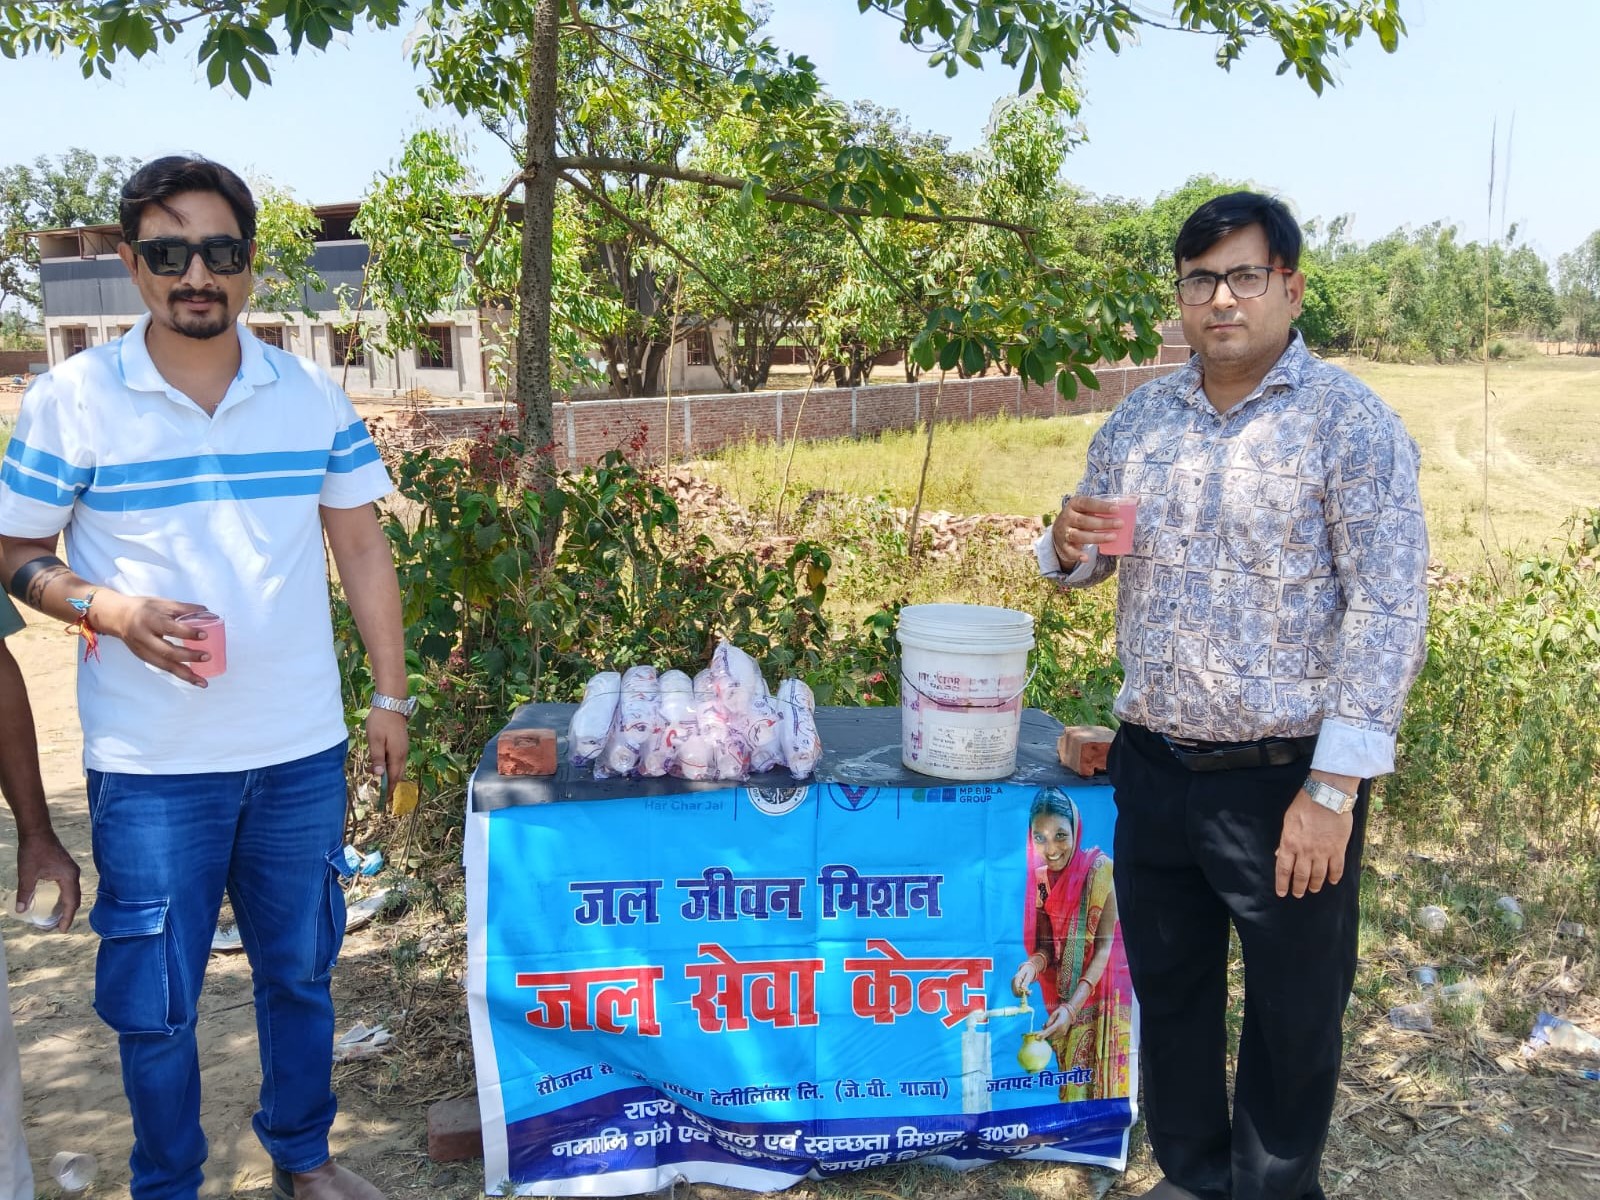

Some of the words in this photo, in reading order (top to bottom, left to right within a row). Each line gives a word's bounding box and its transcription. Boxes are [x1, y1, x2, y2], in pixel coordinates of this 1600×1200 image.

[644, 799, 667, 811] Har
[959, 787, 973, 795] MP
[975, 787, 1003, 795] BIRLA
[959, 795, 992, 804] GROUP
[568, 879, 663, 926] जल
[675, 865, 805, 923] जीवन
[818, 863, 944, 919] मिशन
[515, 965, 664, 1037] जल
[685, 942, 825, 1033] सेवा
[844, 938, 993, 1030] केन्द्र
[535, 1064, 594, 1096] सौजन्य
[797, 1081, 825, 1101] लि.
[900, 1077, 949, 1100] गाजा)
[551, 1126, 628, 1157] नमामि
[633, 1124, 672, 1147] गंगे
[624, 1098, 677, 1120] राज्य
[763, 1129, 802, 1152] एवं
[804, 1133, 891, 1155] स्वच्छता
